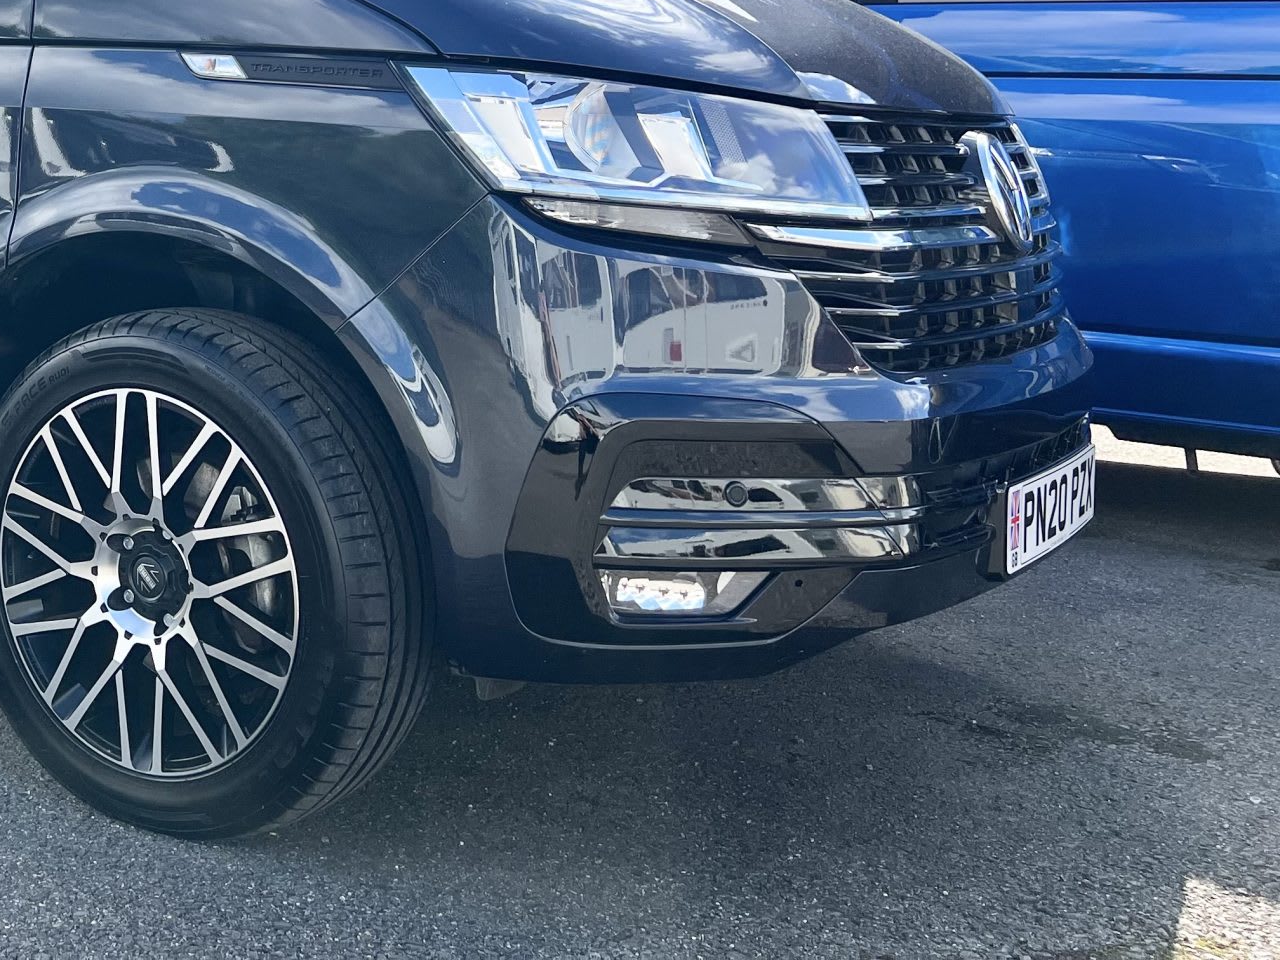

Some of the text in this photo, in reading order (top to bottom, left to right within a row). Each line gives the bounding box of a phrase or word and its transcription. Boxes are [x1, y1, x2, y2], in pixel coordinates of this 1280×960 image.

[251, 64, 383, 78] TRANSPORTER
[1024, 456, 1094, 553] PN20 PZX
